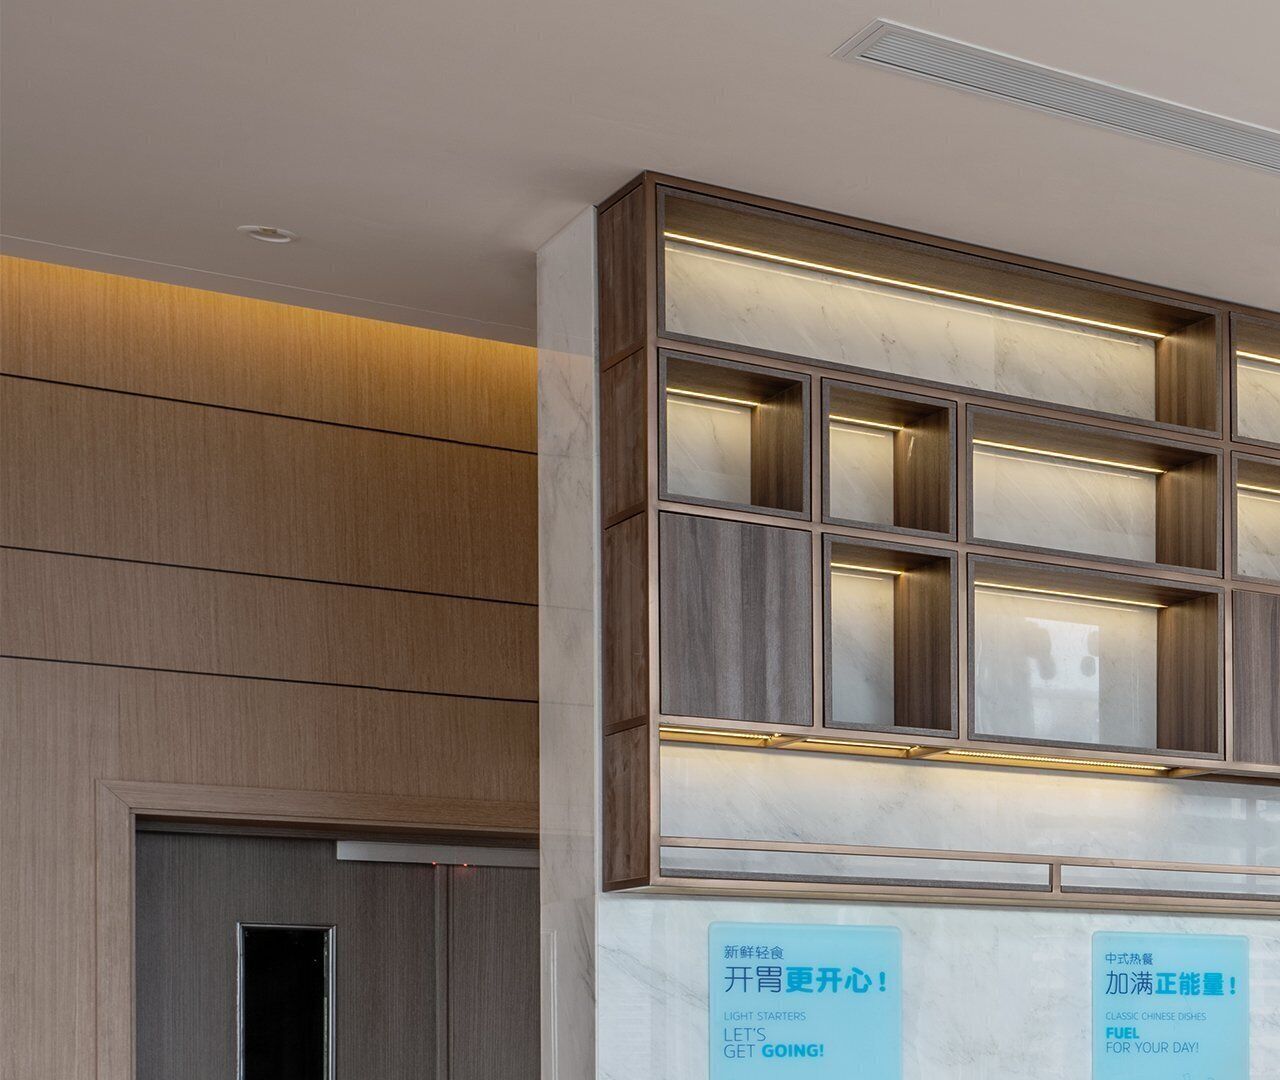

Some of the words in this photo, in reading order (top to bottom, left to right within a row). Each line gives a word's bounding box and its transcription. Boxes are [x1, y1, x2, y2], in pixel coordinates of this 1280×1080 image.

[724, 945, 785, 960] 新鲜轻食
[1105, 951, 1154, 966] 中式热餐
[724, 965, 887, 994] 开胃更开心！
[1105, 970, 1237, 996] 加满正能量！
[724, 1011, 754, 1022] LIGHT
[757, 1011, 807, 1022] STARTERS
[1105, 1011, 1139, 1021] CLASSIC
[1141, 1011, 1176, 1021] CHINESE
[1178, 1012, 1207, 1021] DISHES
[724, 1027, 767, 1043] LET'S
[1105, 1026, 1140, 1040] FUEL
[723, 1043, 756, 1059] GET
[761, 1043, 825, 1059] GOING!
[1106, 1041, 1131, 1054] FOR
[1135, 1041, 1170, 1054] YOUR
[1173, 1041, 1200, 1054] DAY!
